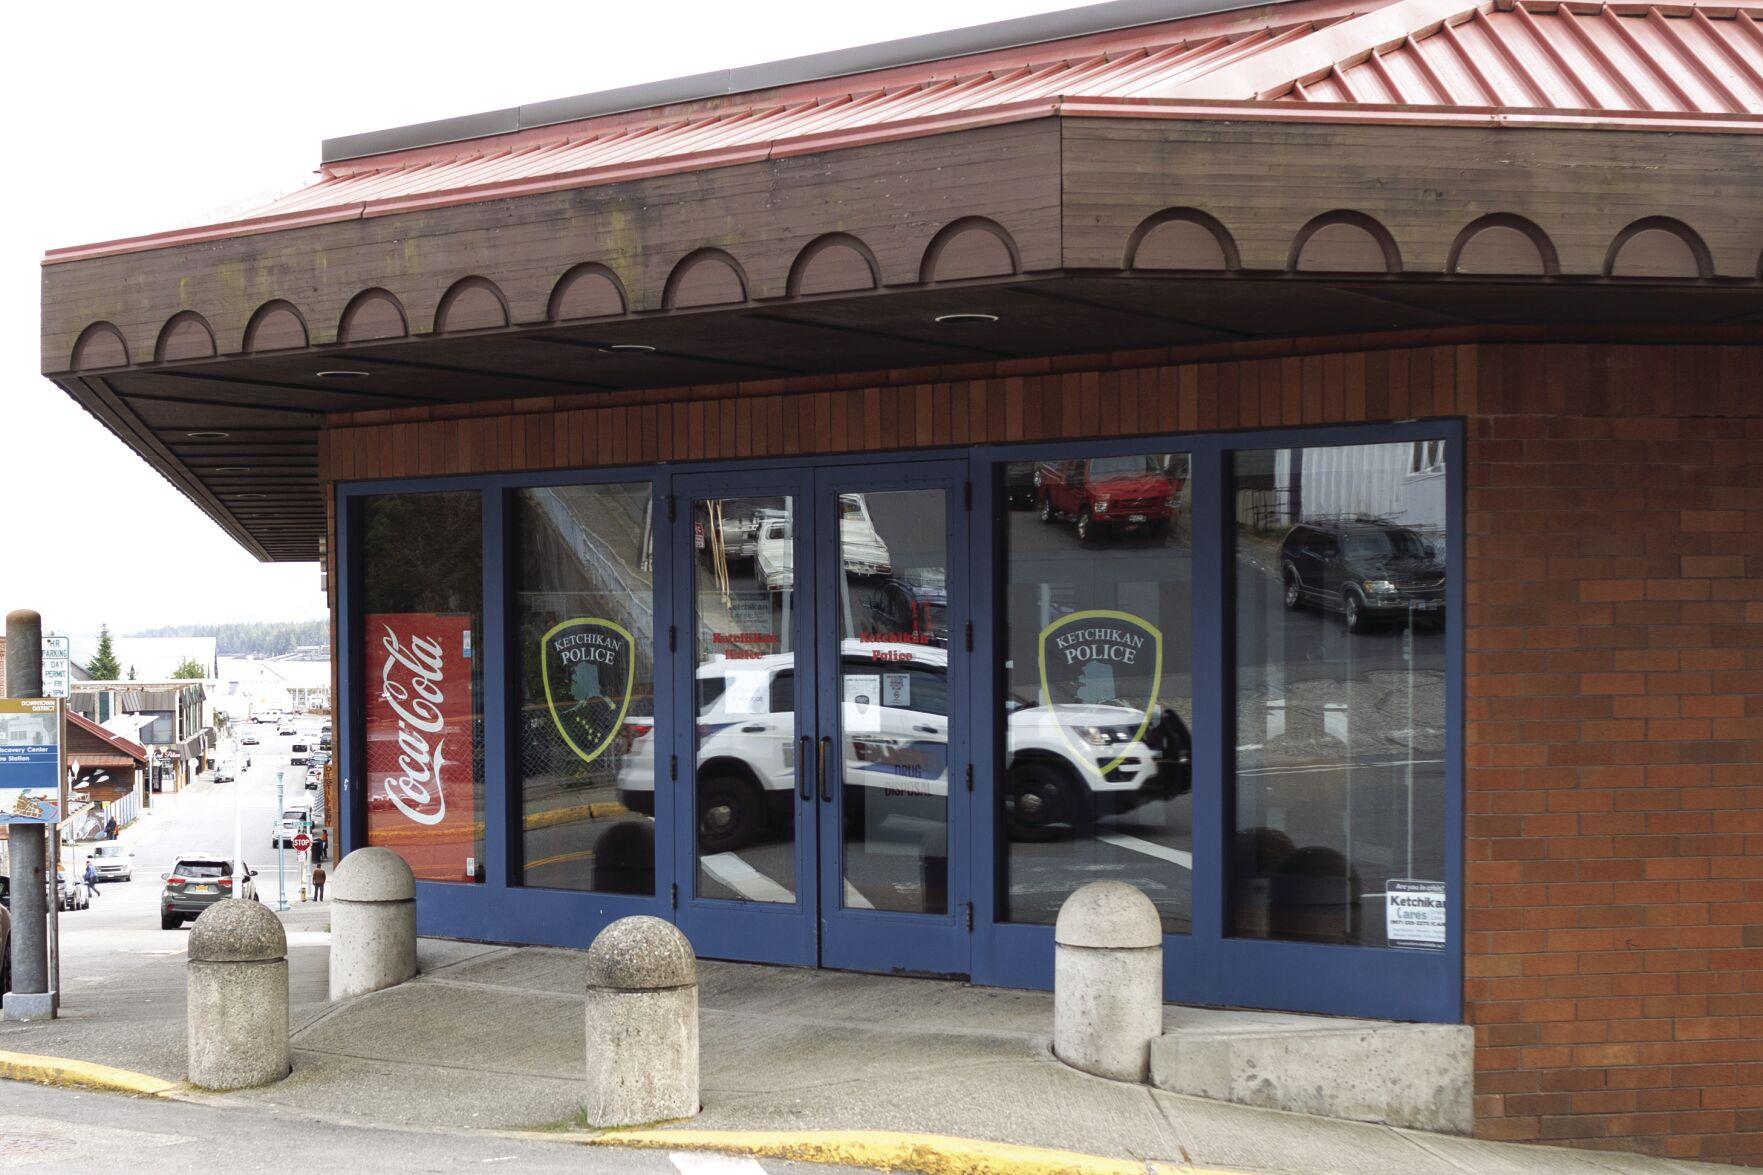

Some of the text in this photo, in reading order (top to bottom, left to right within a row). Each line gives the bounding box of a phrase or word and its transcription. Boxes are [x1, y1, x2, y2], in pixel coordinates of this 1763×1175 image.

[555, 634, 621, 651] KETCHIKAN
[860, 631, 929, 643] Ketchikan
[1056, 628, 1144, 649] KETCHIKAN
[561, 647, 615, 665] POLICE
[872, 649, 913, 661] Police
[1066, 645, 1136, 664] POLICE
[45, 670, 66, 678] PERMIT
[383, 623, 446, 825] Coca-Cola
[895, 764, 922, 777] DRUG
[885, 781, 933, 796] DISPOSAL
[294, 839, 309, 847] STOP
[1390, 896, 1444, 908] Ketchika
[1397, 907, 1427, 919] Cares
